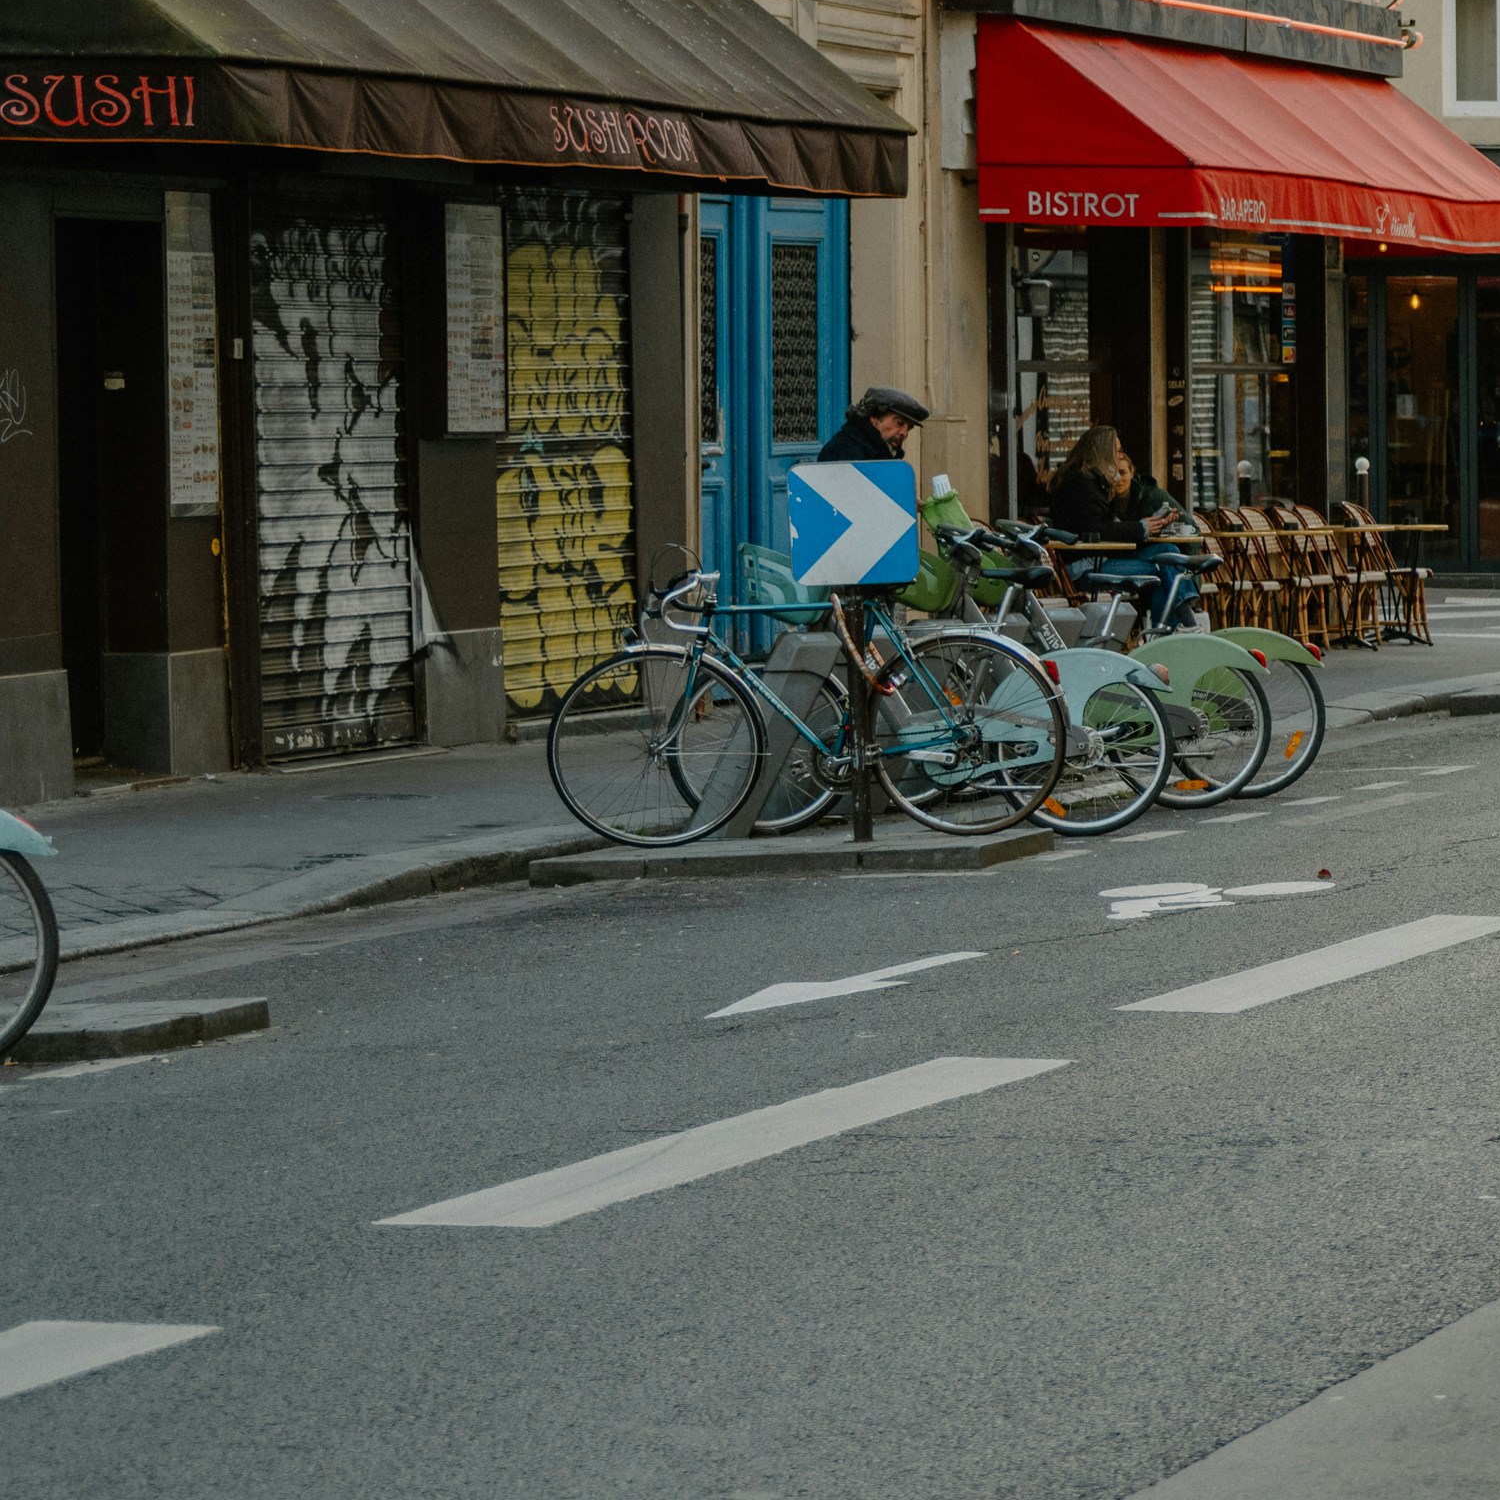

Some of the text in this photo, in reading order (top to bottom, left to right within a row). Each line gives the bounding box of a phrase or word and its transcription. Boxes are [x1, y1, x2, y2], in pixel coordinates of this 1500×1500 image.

[0, 74, 195, 127] SUSHI
[550, 102, 698, 164] SUSHI ROOM
[1028, 191, 1140, 218] BISTROT
